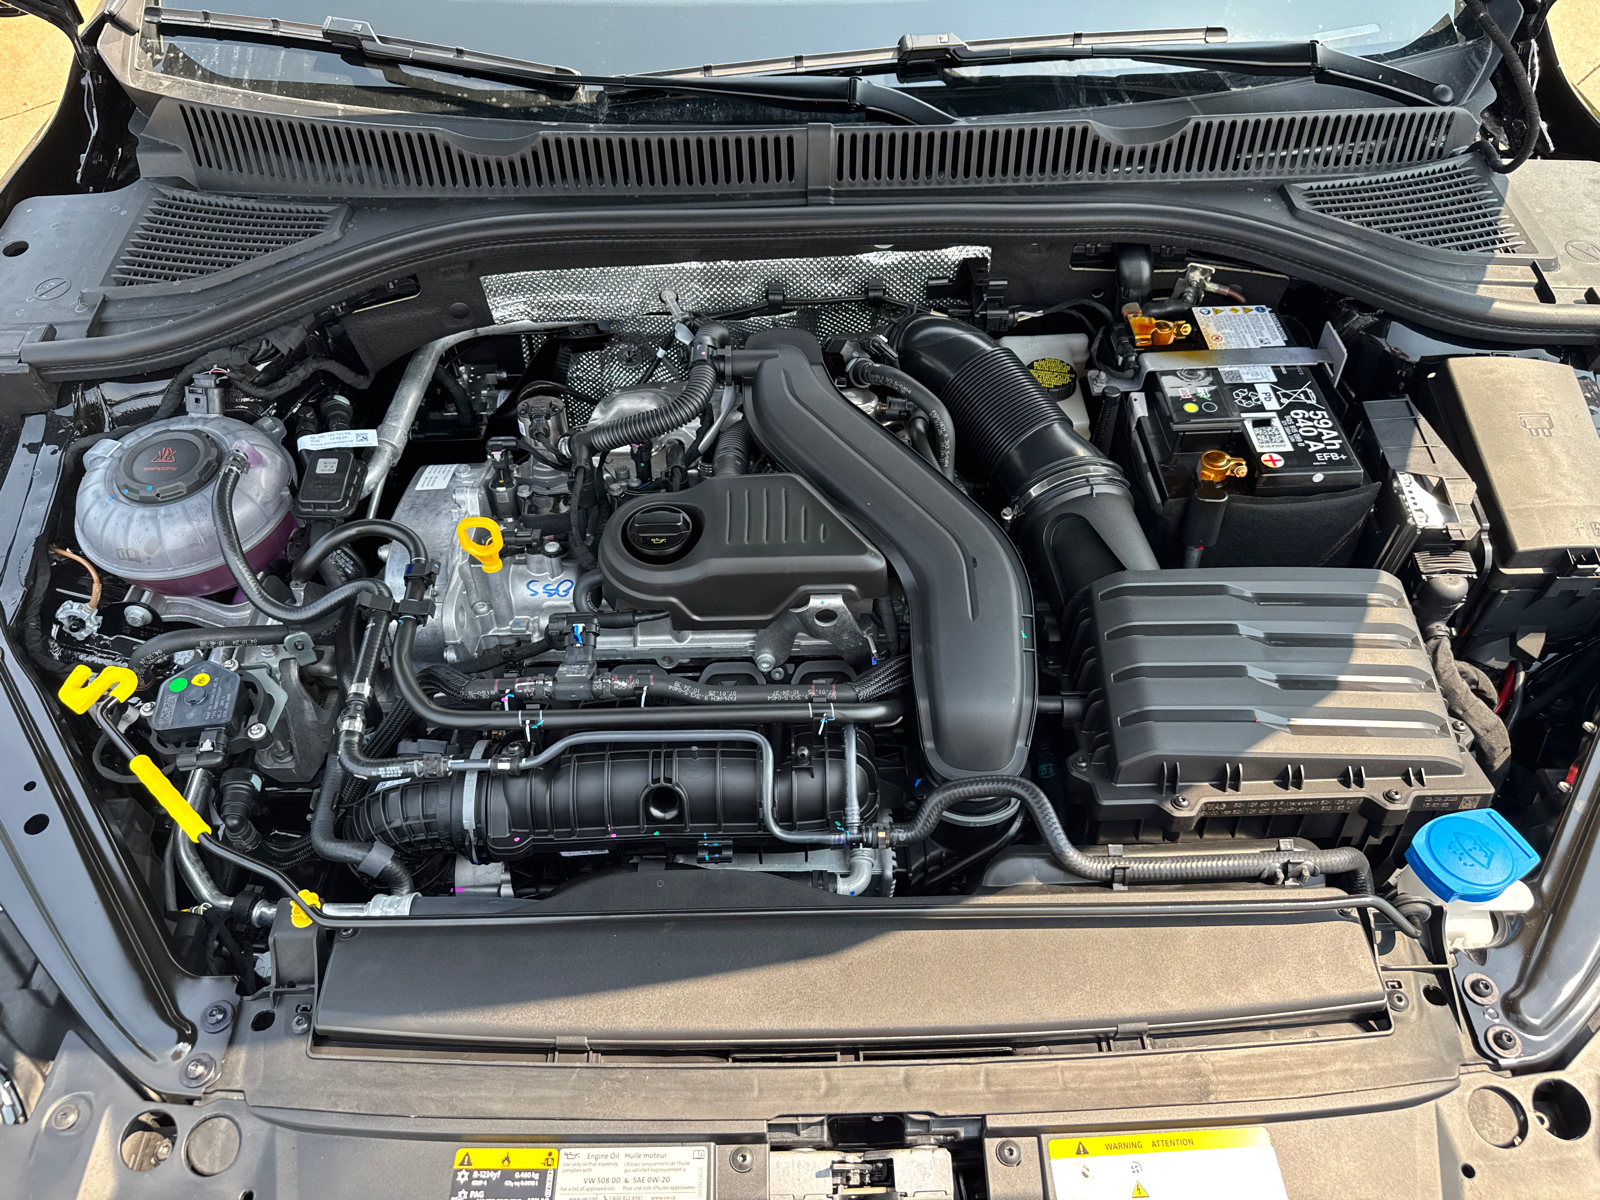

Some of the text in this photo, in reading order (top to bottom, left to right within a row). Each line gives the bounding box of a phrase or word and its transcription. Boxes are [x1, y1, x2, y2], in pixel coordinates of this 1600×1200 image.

[1262, 392, 1272, 402] Pb
[1290, 410, 1318, 436] 640
[1304, 440, 1326, 452] A
[1309, 410, 1343, 450] 59Ah
[1316, 453, 1348, 461] EFB+
[1104, 1138, 1194, 1150] WARNING ATTENTION
[587, 1153, 609, 1161] Engine
[473, 1170, 501, 1180] R-1234yf
